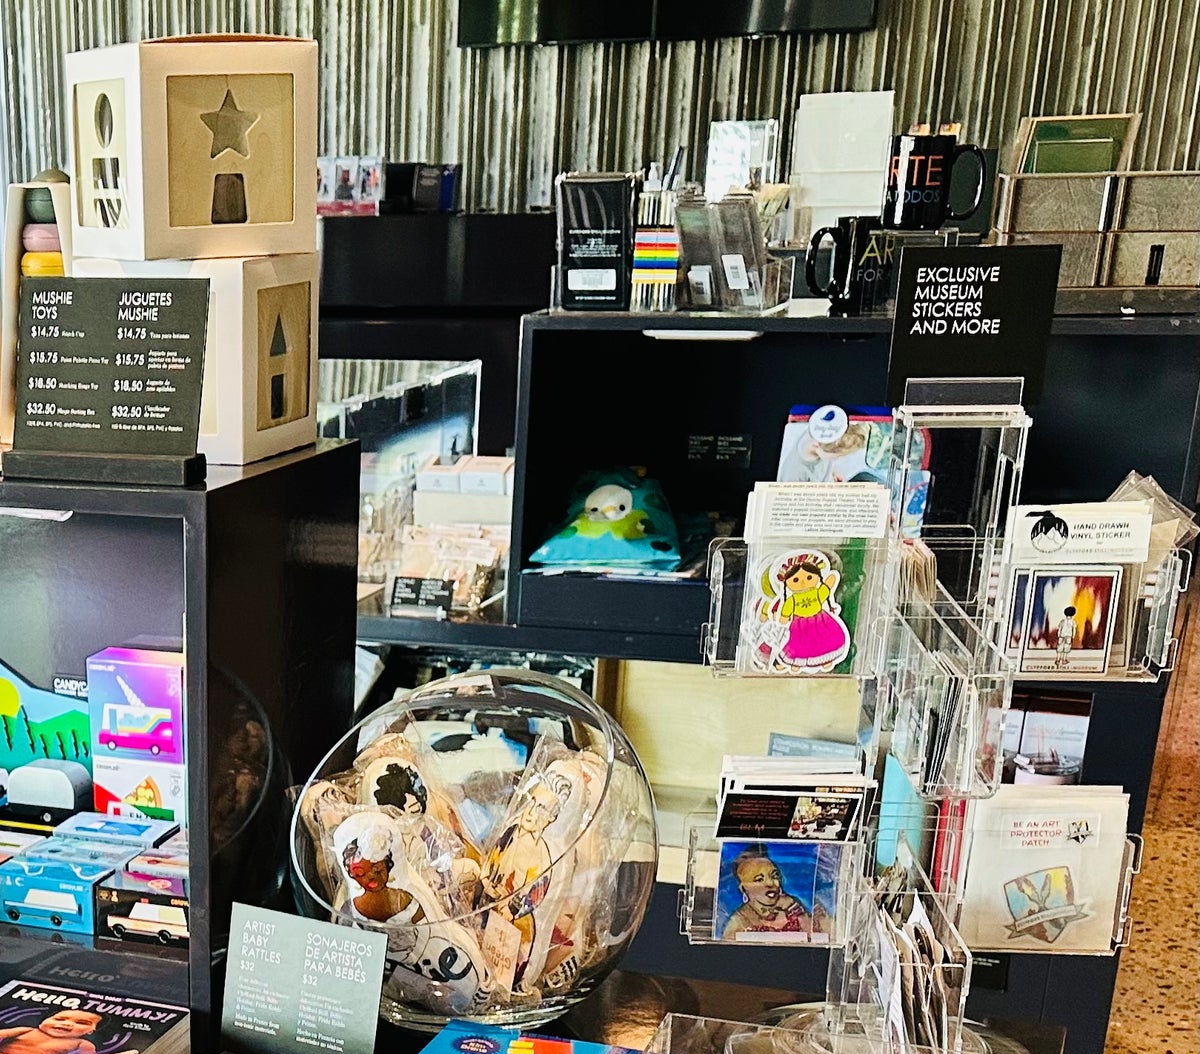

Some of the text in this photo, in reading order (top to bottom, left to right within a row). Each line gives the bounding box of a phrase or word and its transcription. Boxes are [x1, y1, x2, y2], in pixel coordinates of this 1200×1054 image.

[917, 266, 1000, 283] EXCLUSIVE
[32, 291, 73, 305] MUSHIE
[118, 292, 173, 306] JUGUETES
[914, 285, 983, 300] MUSEUM
[31, 305, 58, 320] TOYS
[117, 307, 159, 321] MUSHIE
[912, 301, 982, 318] STICKERS
[31, 325, 60, 339] $14.75
[117, 327, 147, 340] $14.75
[910, 319, 1000, 335] AND MORE
[29, 351, 58, 365] $15.75
[115, 353, 145, 366] $15.75
[26, 402, 56, 416] $32.50
[111, 405, 142, 419] $32.50
[1070, 531, 1131, 540] VINYL STICKER
[1010, 830, 1062, 838] PROTECTOR
[243, 919, 276, 936] ARTIST
[242, 932, 269, 946] BABY
[307, 932, 373, 957] SONAJEROS
[241, 946, 282, 965] RATTLES
[305, 946, 363, 969] DE ARTISTA
[240, 960, 255, 972] $32
[303, 960, 367, 984] PARA BEBÉS
[302, 973, 318, 986] $32
